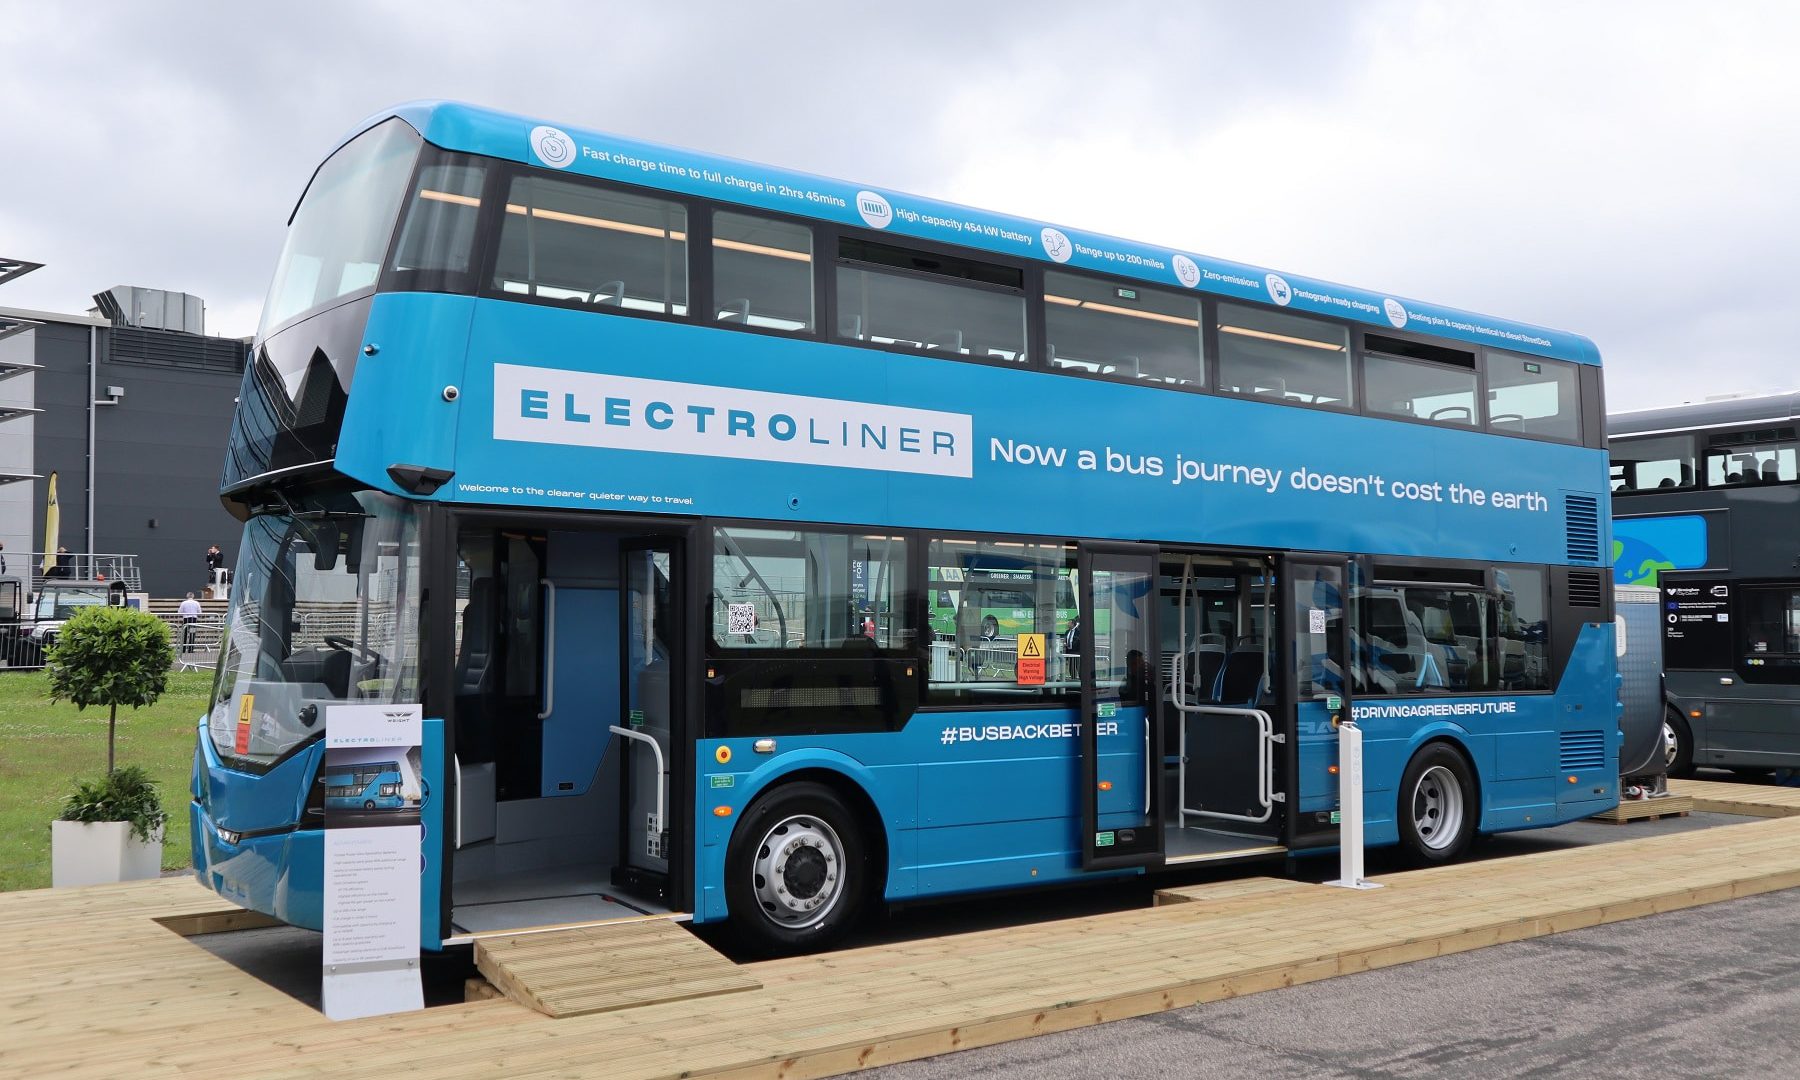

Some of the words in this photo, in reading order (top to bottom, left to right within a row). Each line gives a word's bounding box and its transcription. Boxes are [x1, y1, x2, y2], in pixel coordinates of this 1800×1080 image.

[583, 146, 610, 161] Fast
[613, 154, 656, 171] charge
[659, 163, 685, 176] time
[689, 168, 700, 178] to
[703, 170, 721, 182] full
[725, 176, 763, 191] charge
[766, 183, 776, 193] in
[779, 186, 803, 198] 2hrs
[806, 192, 845, 206] 45mins
[896, 208, 920, 223] High
[922, 216, 962, 231] capacity
[965, 222, 982, 233] 454
[984, 226, 998, 236] kW
[1000, 229, 1031, 244] battery
[1075, 244, 1102, 257] Range
[1103, 252, 1115, 262] up
[1116, 253, 1125, 261] to
[1126, 254, 1144, 264] 200
[1143, 257, 1165, 269] miles
[1203, 269, 1259, 287] Zero-emissions
[1293, 288, 1332, 303] Pantograph
[1333, 295, 1351, 309] ready
[1352, 300, 1380, 314] charging
[1408, 311, 1432, 325] Seating
[1432, 316, 1445, 326] plan
[521, 389, 954, 456] ELECTROLINER
[991, 438, 1066, 466] Now
[1078, 451, 1096, 469] a
[1107, 447, 1163, 476] bus
[1173, 454, 1282, 493] journey
[1291, 467, 1384, 496] doesn't
[1392, 482, 1442, 501] cost
[1449, 483, 1485, 505] the
[1492, 492, 1547, 511] earth
[459, 483, 509, 494] Welcome
[511, 486, 524, 495] to
[526, 487, 545, 496] the
[546, 488, 586, 499] cleaner
[589, 491, 625, 502] quieter
[627, 494, 649, 505] way
[651, 495, 663, 503] to
[664, 495, 694, 505] travel.
[1352, 701, 1517, 721] #DRIVINGAGREENERFUTURE
[334, 736, 403, 744] ELECTROLINER
[940, 722, 1118, 745] #BUSBACKBETER
